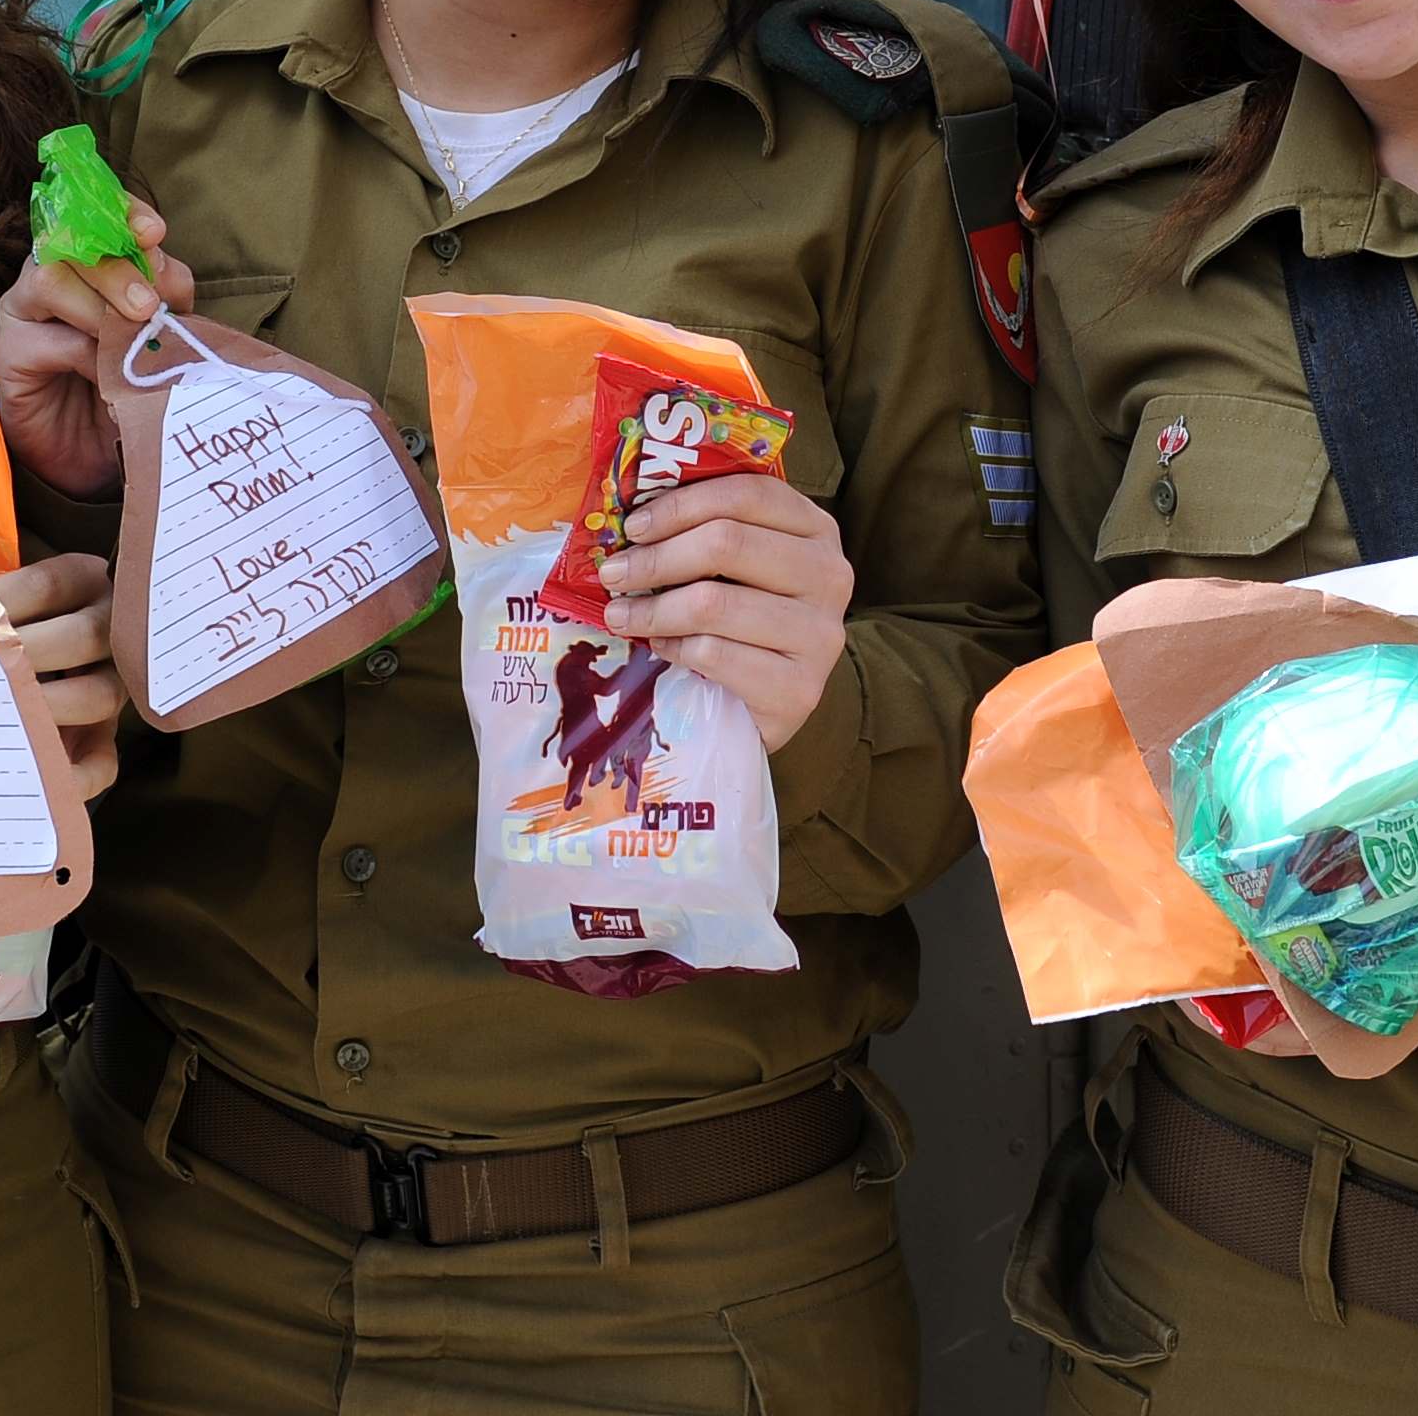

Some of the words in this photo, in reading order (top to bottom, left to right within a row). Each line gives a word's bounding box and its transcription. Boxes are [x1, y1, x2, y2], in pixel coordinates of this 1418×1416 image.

[173, 405, 285, 471] Happy
[213, 540, 313, 593] Love,
[506, 590, 581, 623] לוח
[494, 625, 549, 653] מנות
[503, 655, 537, 678] איש
[491, 678, 548, 704] לרעהו
[641, 801, 715, 831] פורים
[1375, 814, 1415, 833] FRUIT
[607, 829, 678, 858] שמח
